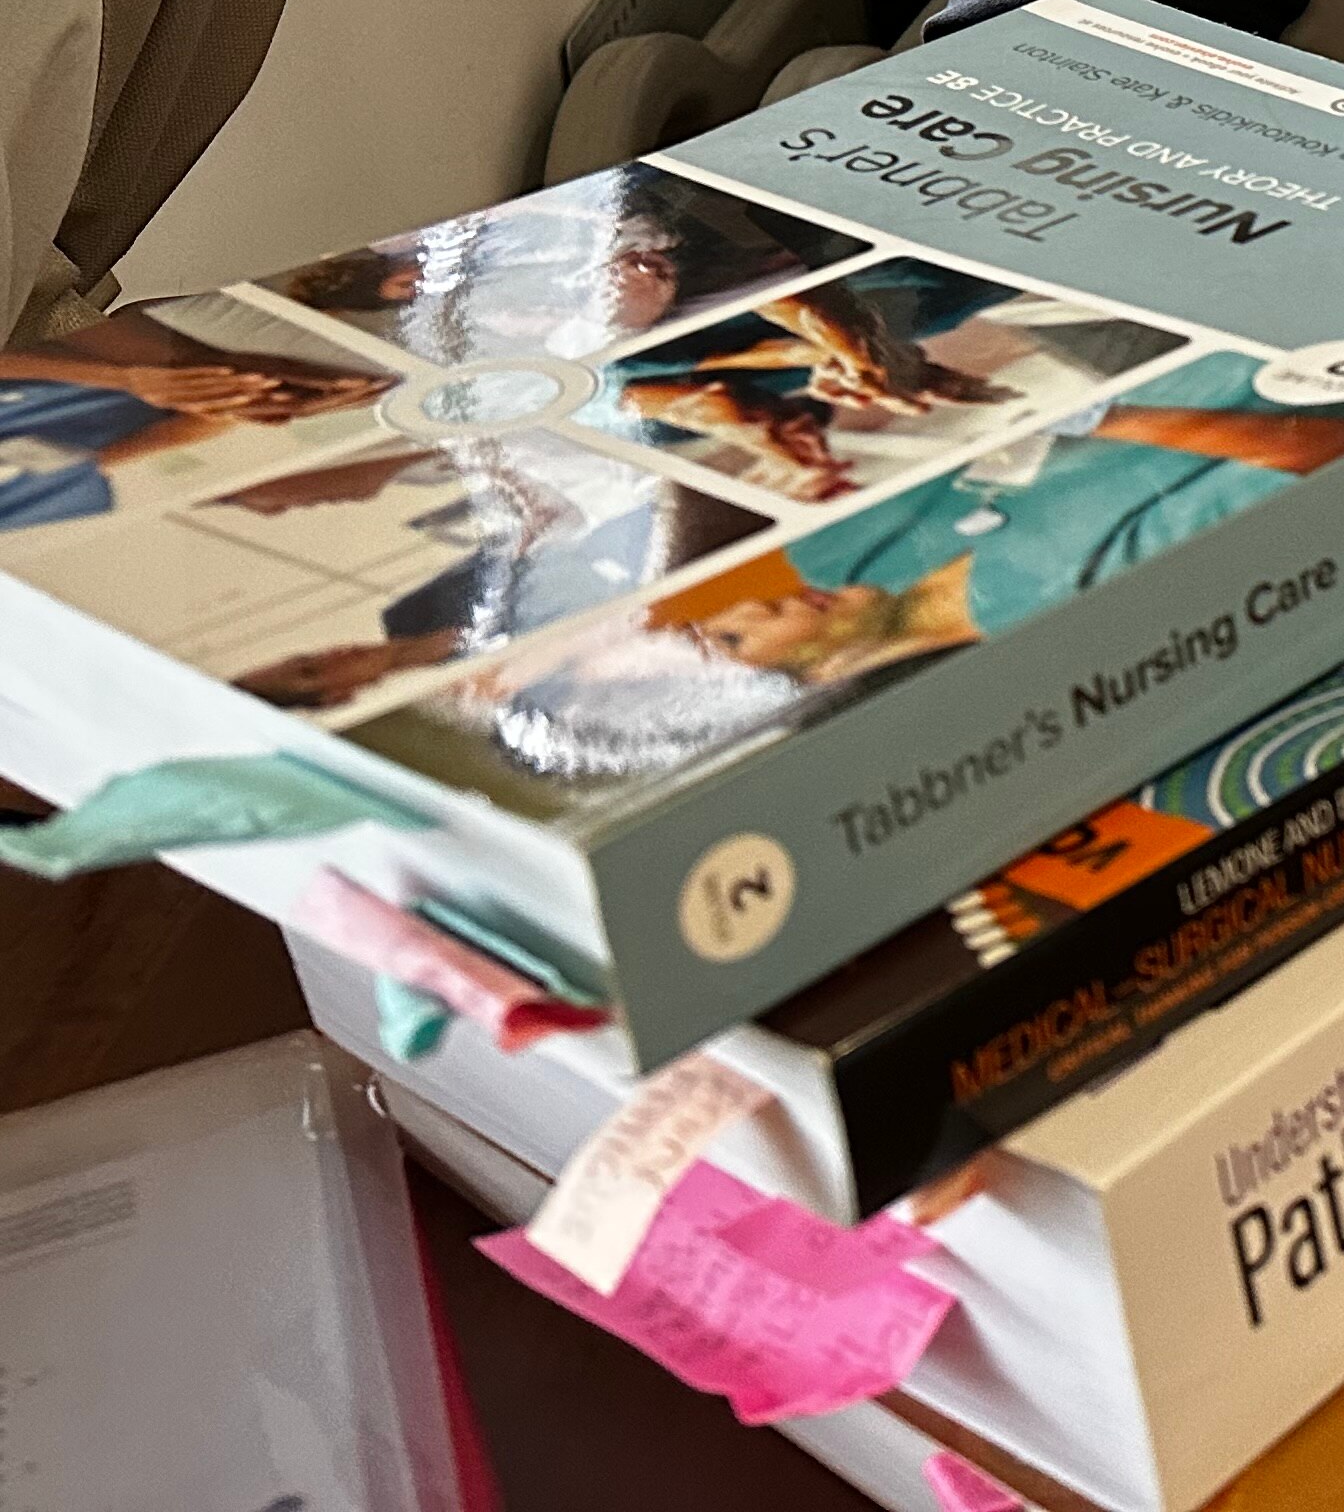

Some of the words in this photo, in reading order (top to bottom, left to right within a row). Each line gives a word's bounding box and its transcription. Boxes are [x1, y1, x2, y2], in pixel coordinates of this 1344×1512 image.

[926, 68, 968, 89] 8E
[1012, 41, 1113, 86] Stainton
[1111, 75, 1166, 104] Kate
[974, 85, 1122, 148] PRACTICE
[1166, 90, 1194, 110] &
[860, 93, 1015, 162] Care
[1126, 138, 1208, 179] AND
[780, 126, 1082, 245] Tabbner's
[1012, 146, 1292, 246] Nursing
[1207, 163, 1342, 211] THEORY
[832, 705, 1064, 859] Tabbner's
[1066, 606, 1239, 730] Nursing
[1243, 551, 1342, 627] Care
[1285, 797, 1336, 850] AND
[724, 862, 774, 916] 2
